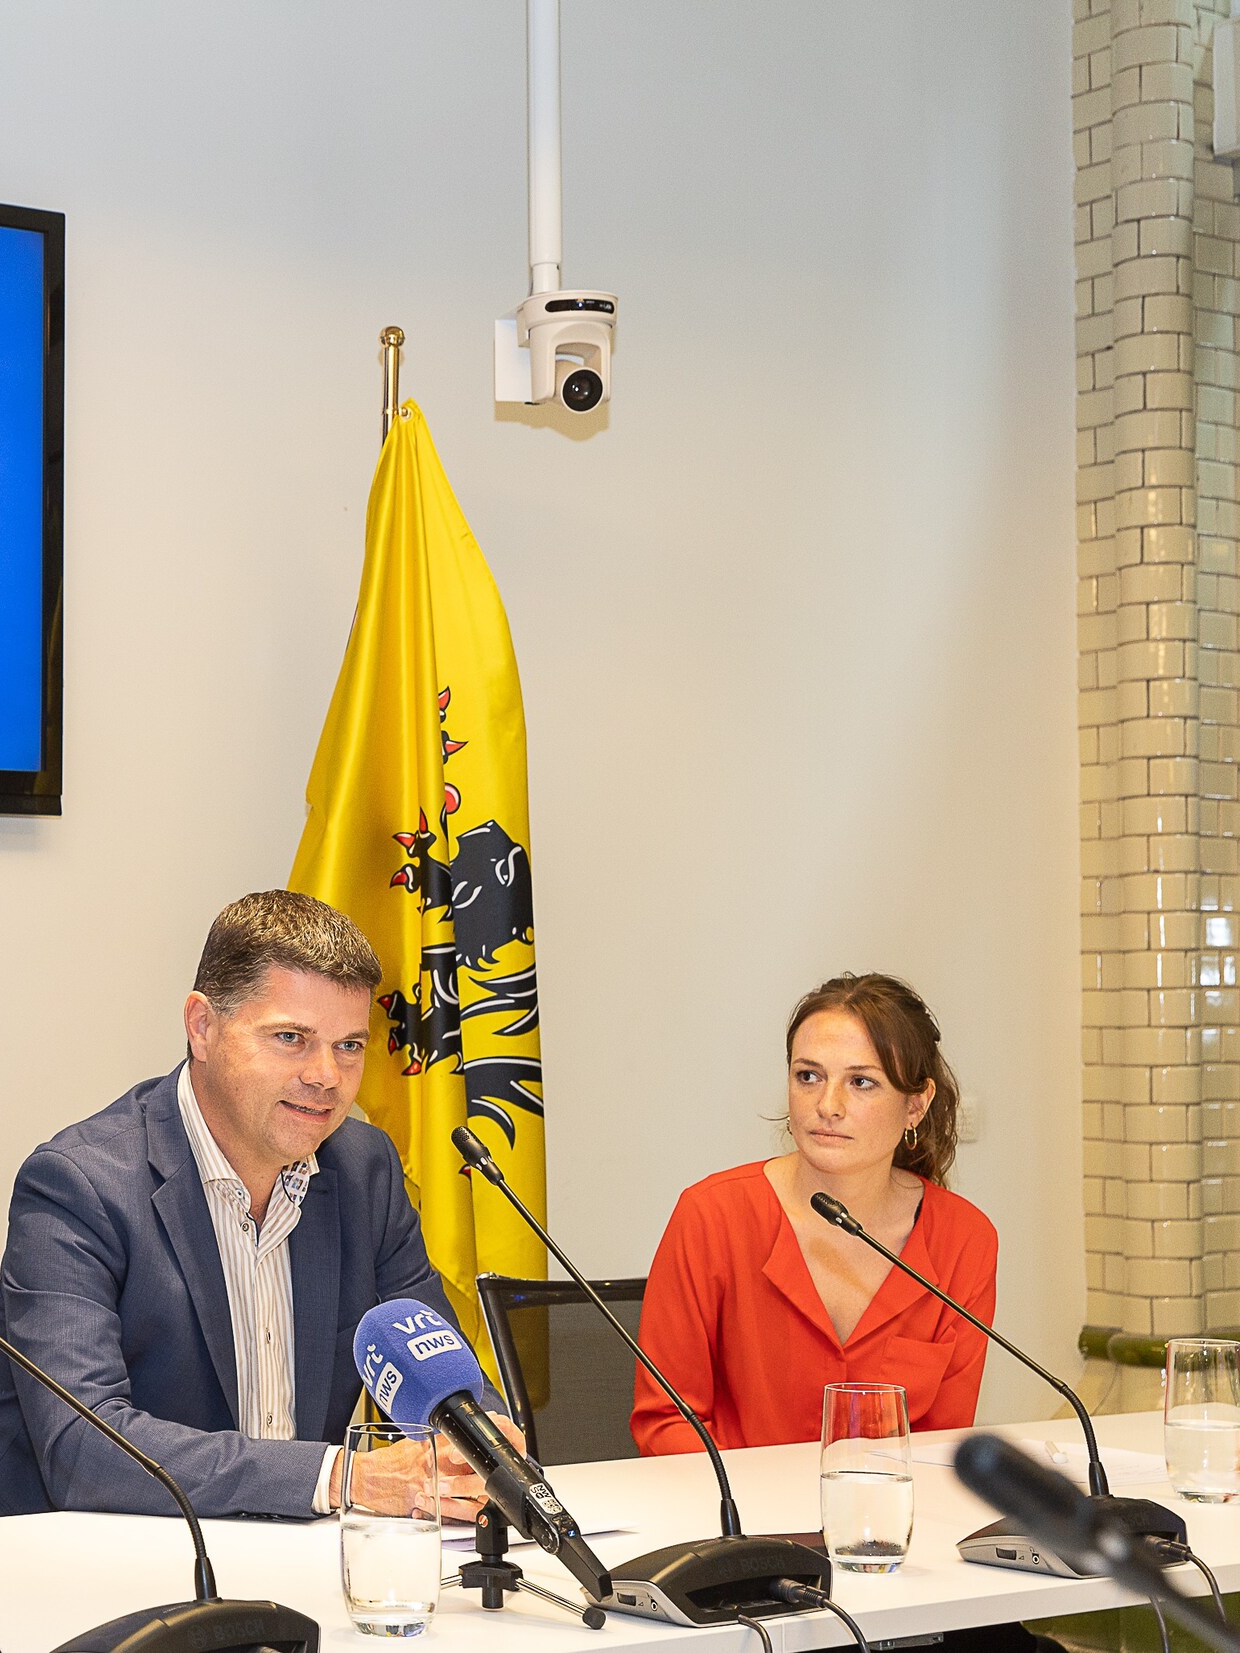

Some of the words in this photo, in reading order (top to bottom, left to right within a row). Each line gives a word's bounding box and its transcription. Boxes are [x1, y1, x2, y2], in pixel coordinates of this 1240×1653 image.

[392, 1309, 443, 1335] vrt
[415, 1334, 455, 1355] nws
[362, 1343, 384, 1388] vrt
[379, 1370, 397, 1408] nws
[213, 1618, 266, 1642] BOSCH
